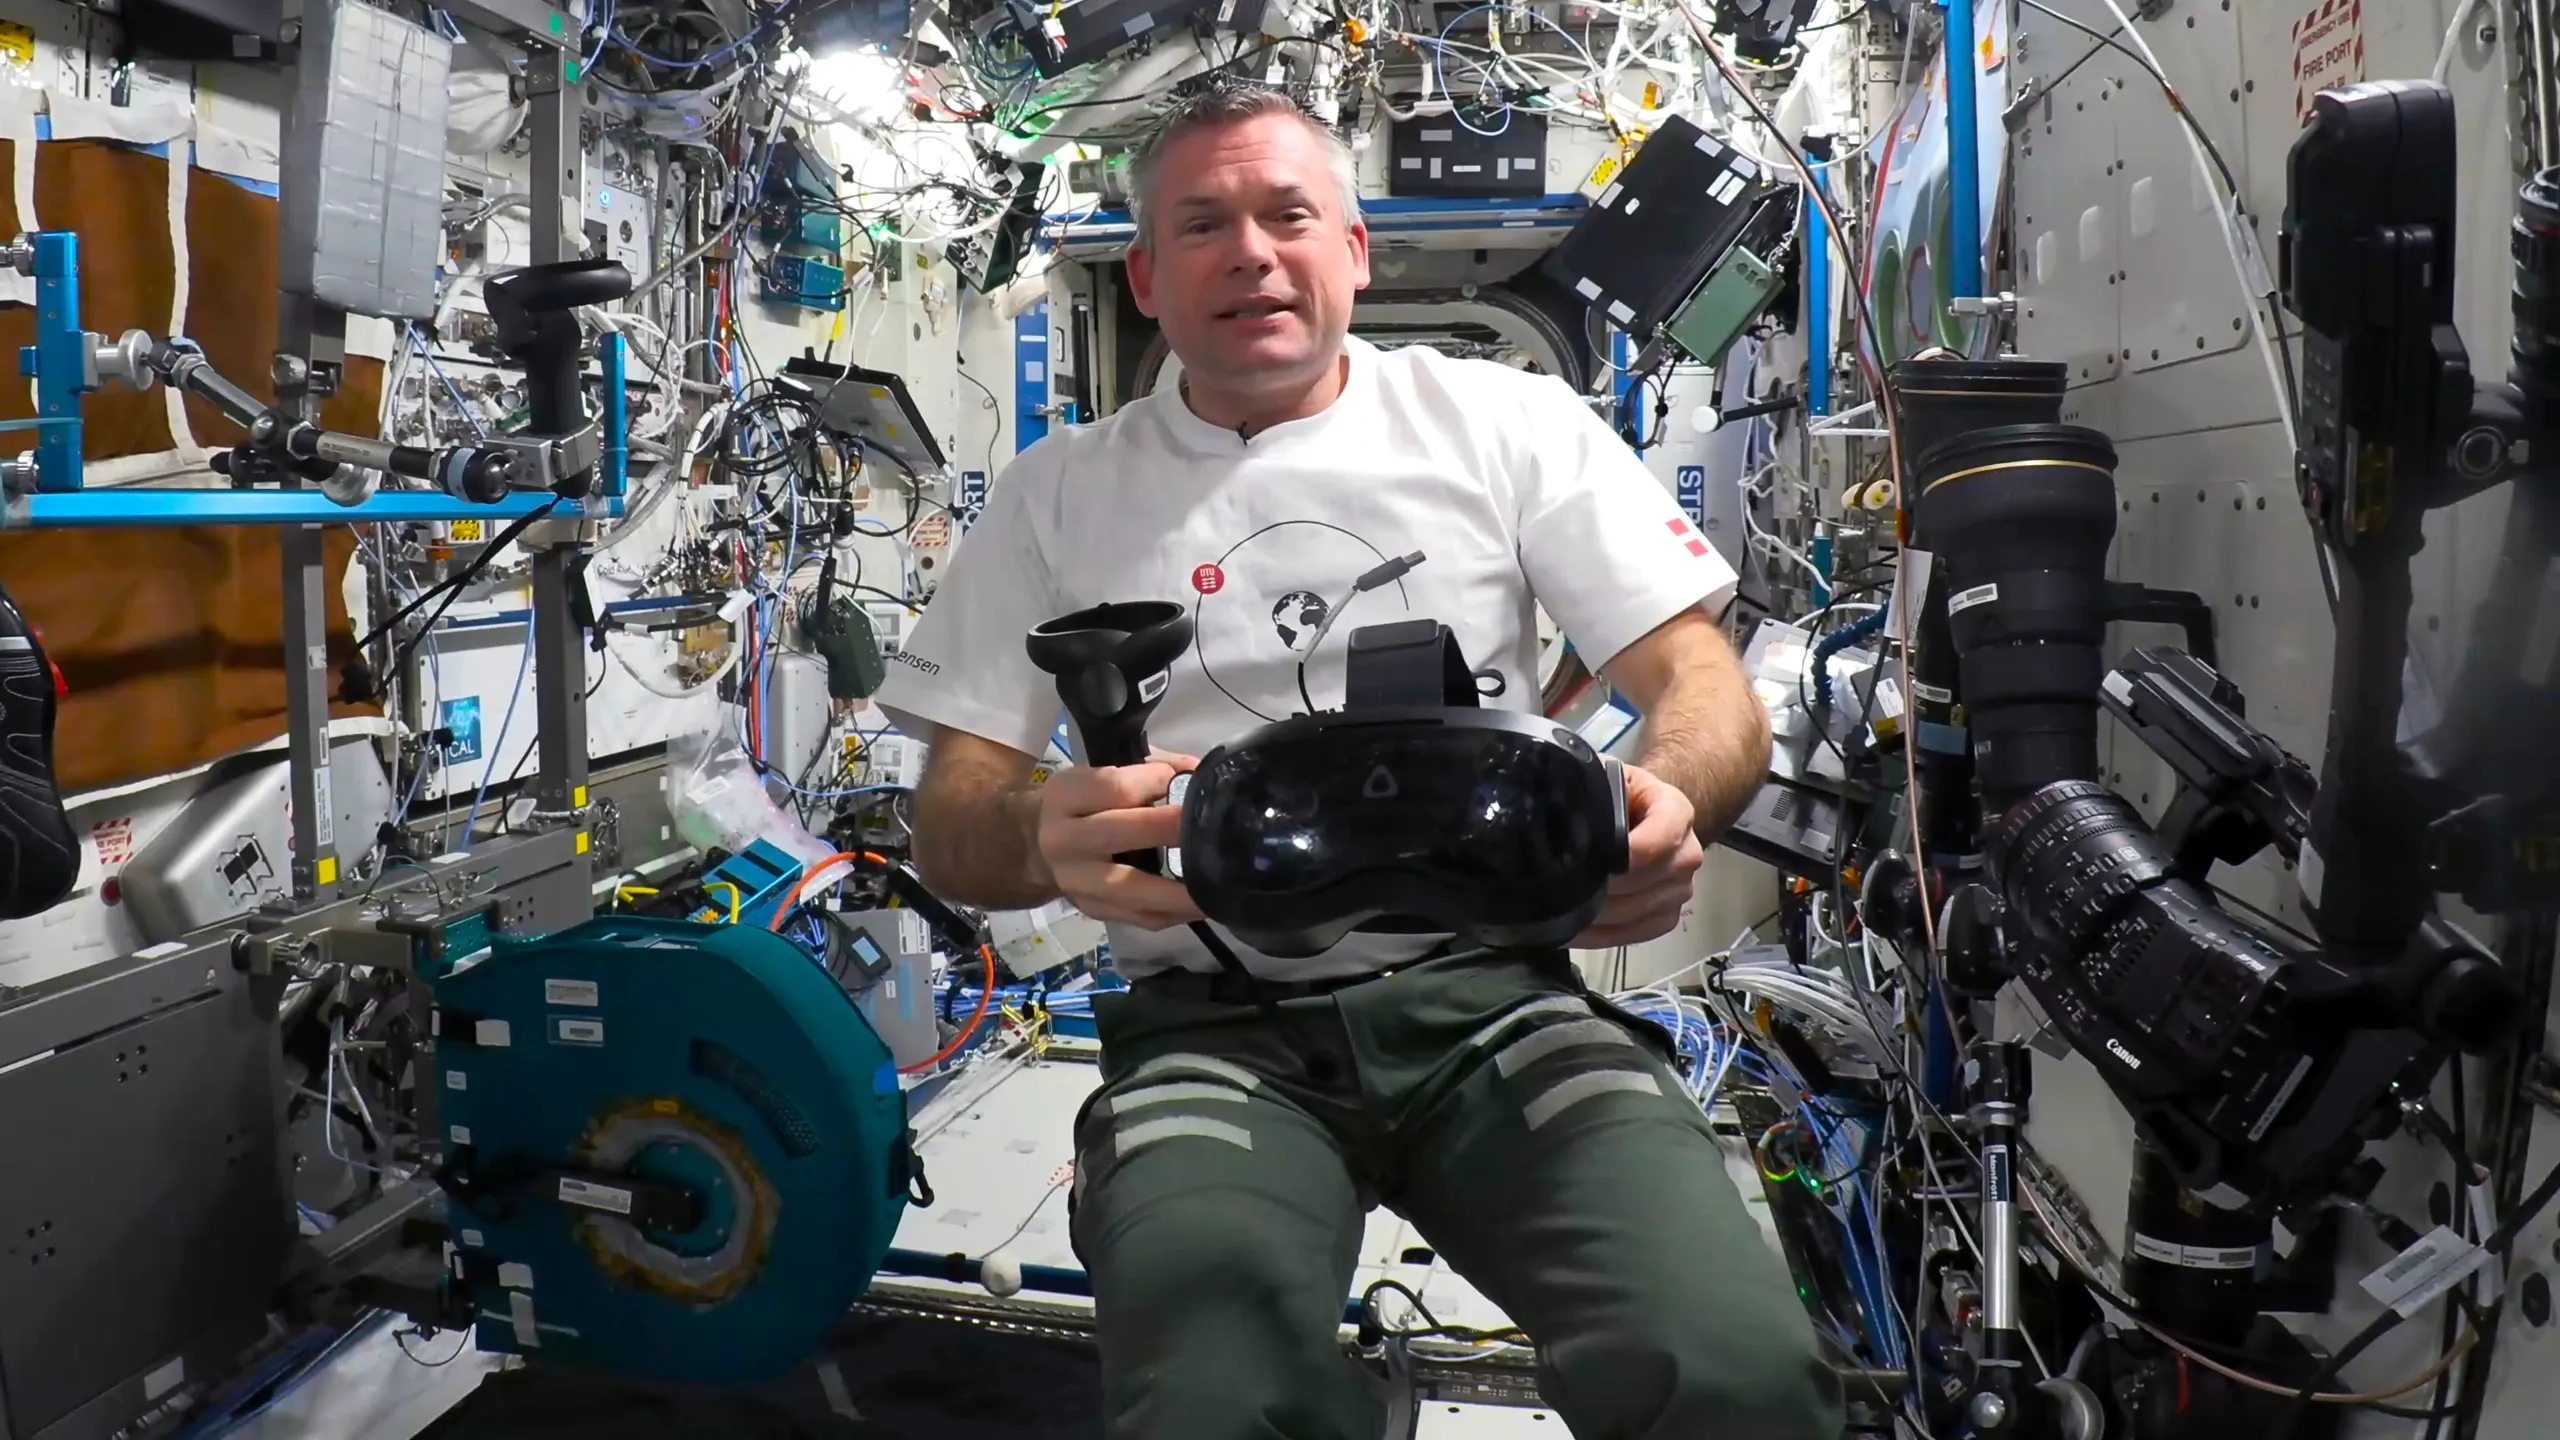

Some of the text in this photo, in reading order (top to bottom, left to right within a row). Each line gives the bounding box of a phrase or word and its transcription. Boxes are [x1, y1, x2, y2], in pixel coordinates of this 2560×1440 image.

[2303, 38, 2352, 81] FIRE PORT
[964, 474, 984, 527] ORT
[1200, 567, 1215, 577] DTU
[898, 648, 941, 676] ensen
[449, 739, 475, 758] CAL
[2106, 1038, 2141, 1070] Canon
[1990, 1154, 1998, 1201] Manfrott
